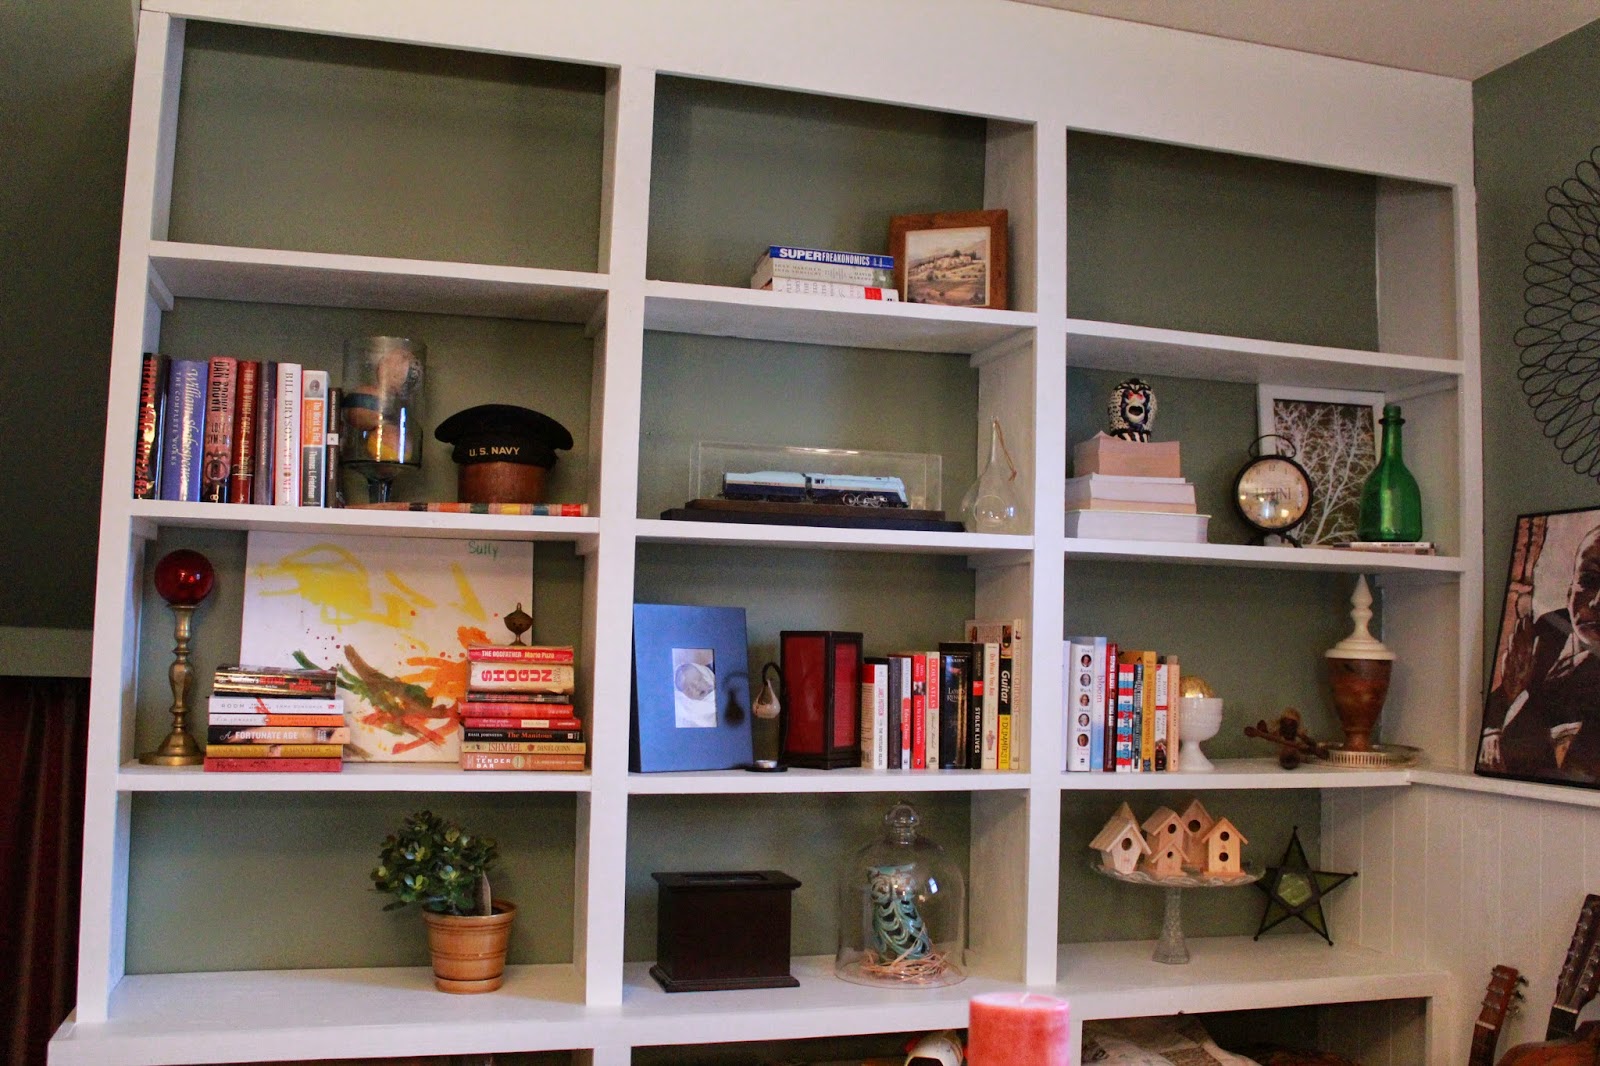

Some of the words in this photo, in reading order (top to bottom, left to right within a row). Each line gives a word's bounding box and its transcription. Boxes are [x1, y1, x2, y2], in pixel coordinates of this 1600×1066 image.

[779, 248, 870, 266] SUPERFREAKONOMICS
[213, 361, 230, 379] DAN
[244, 369, 254, 383] THE
[183, 368, 201, 416] William
[243, 384, 253, 395] DA
[284, 372, 294, 396] BILL
[211, 381, 228, 413] BROWN
[242, 395, 252, 415] VINCI
[314, 402, 322, 411] The
[172, 390, 181, 434] COMPLETE
[283, 400, 293, 442] BRYSON
[313, 412, 322, 426] World
[170, 436, 179, 466] WORKS
[176, 415, 200, 486] Shakespeare
[309, 451, 317, 470] Thomas
[491, 446, 521, 456] NAVY
[308, 475, 317, 498] Friedman
[481, 669, 553, 682] SHOGUN
[930, 660, 938, 684] CLOUD
[930, 686, 938, 708] ATLAS
[1000, 670, 1011, 704] Guitar
[1096, 675, 1105, 703] bloom
[235, 731, 281, 740] FORTUNATE
[283, 731, 298, 740] AGE
[488, 743, 521, 752] ISHMAEL
